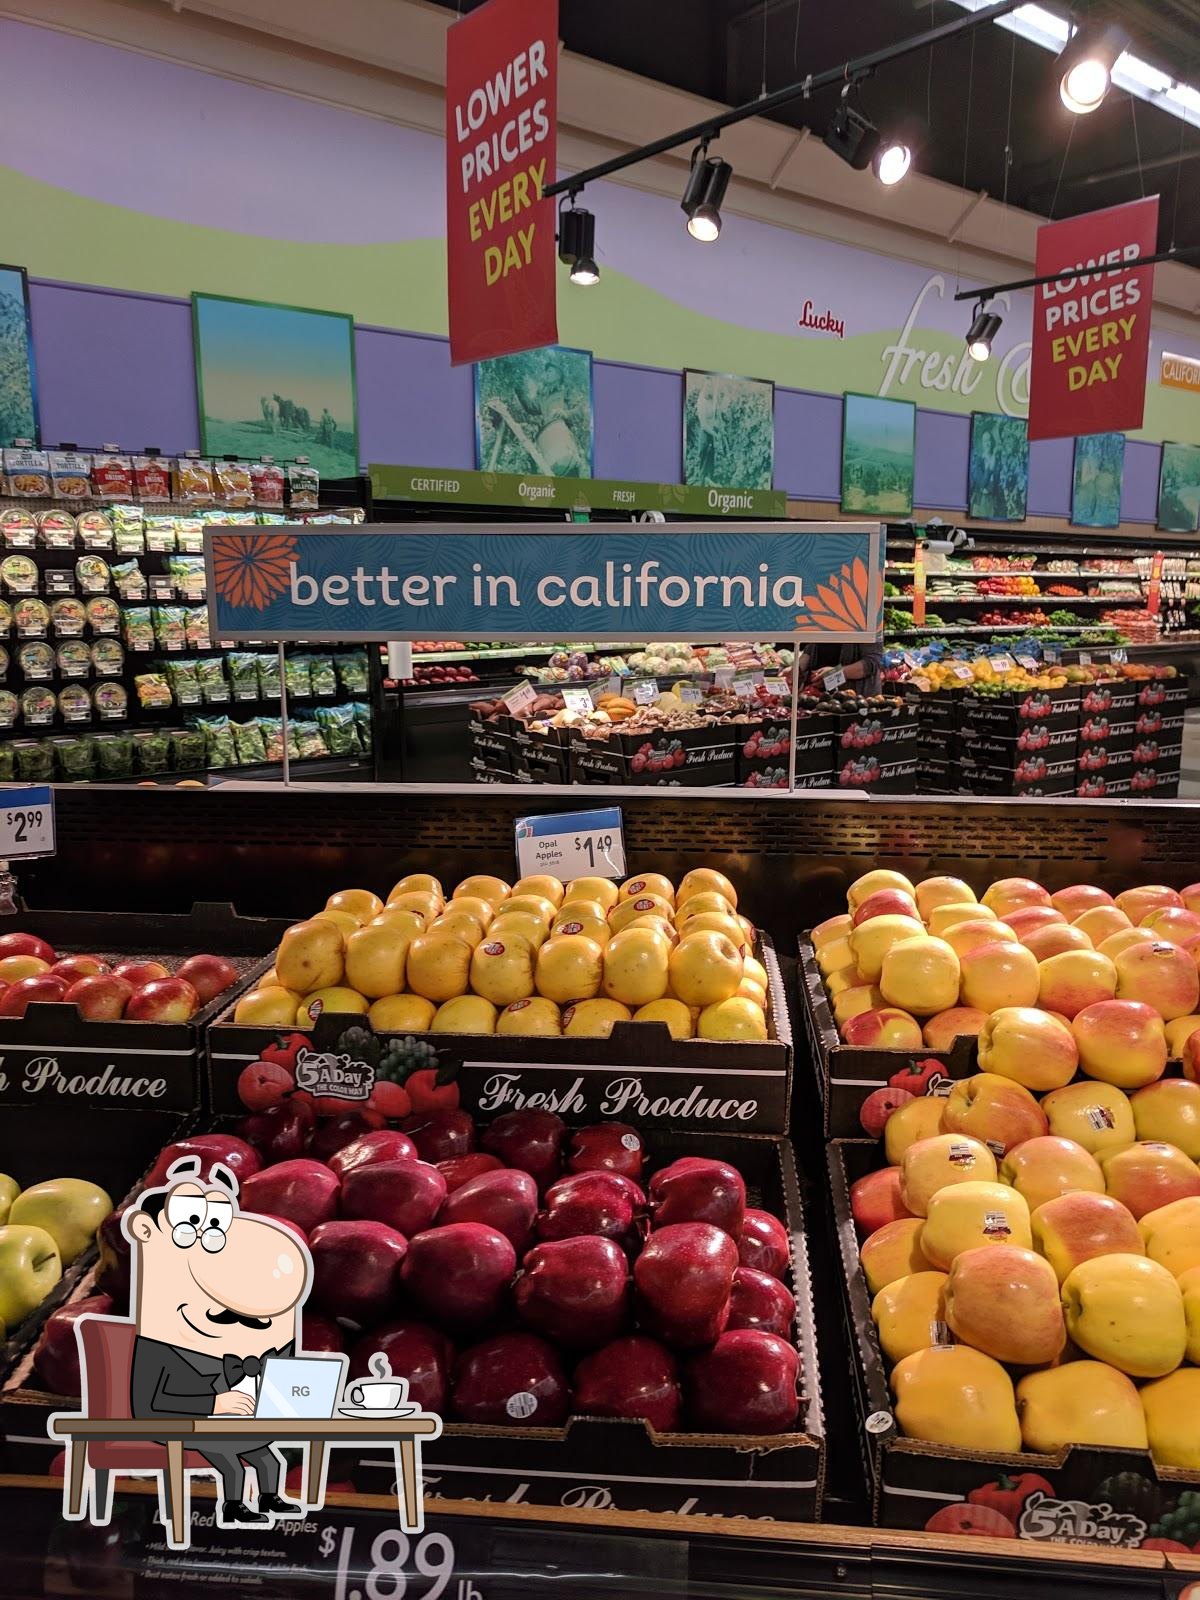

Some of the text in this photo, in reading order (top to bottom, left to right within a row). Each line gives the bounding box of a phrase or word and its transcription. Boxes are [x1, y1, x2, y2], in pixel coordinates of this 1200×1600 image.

[455, 39, 549, 143] LOWER
[461, 98, 549, 193] PRICES
[468, 158, 547, 242] EVERY
[484, 223, 536, 287] DAY
[798, 299, 845, 339] Lucky
[1045, 278, 1141, 332] PRICES
[1052, 313, 1137, 363] EVERY
[1068, 353, 1123, 391] DAY
[411, 478, 460, 493] CERTIFIED
[518, 482, 556, 499] Organic
[612, 490, 635, 503] FRESH
[708, 489, 754, 512] Organic
[289, 560, 805, 608] better in california
[535, 849, 563, 860] Apples
[538, 840, 558, 850] Opal
[21, 1056, 168, 1098] Produce
[302, 1062, 362, 1088] 5 A Day
[478, 1073, 759, 1120] Fresh Produce
[191, 1511, 216, 1528] Red
[274, 1519, 318, 1536] Apples
[1030, 1510, 1057, 1538] 5
[1058, 1519, 1076, 1536] A
[1078, 1521, 1127, 1544] Day
